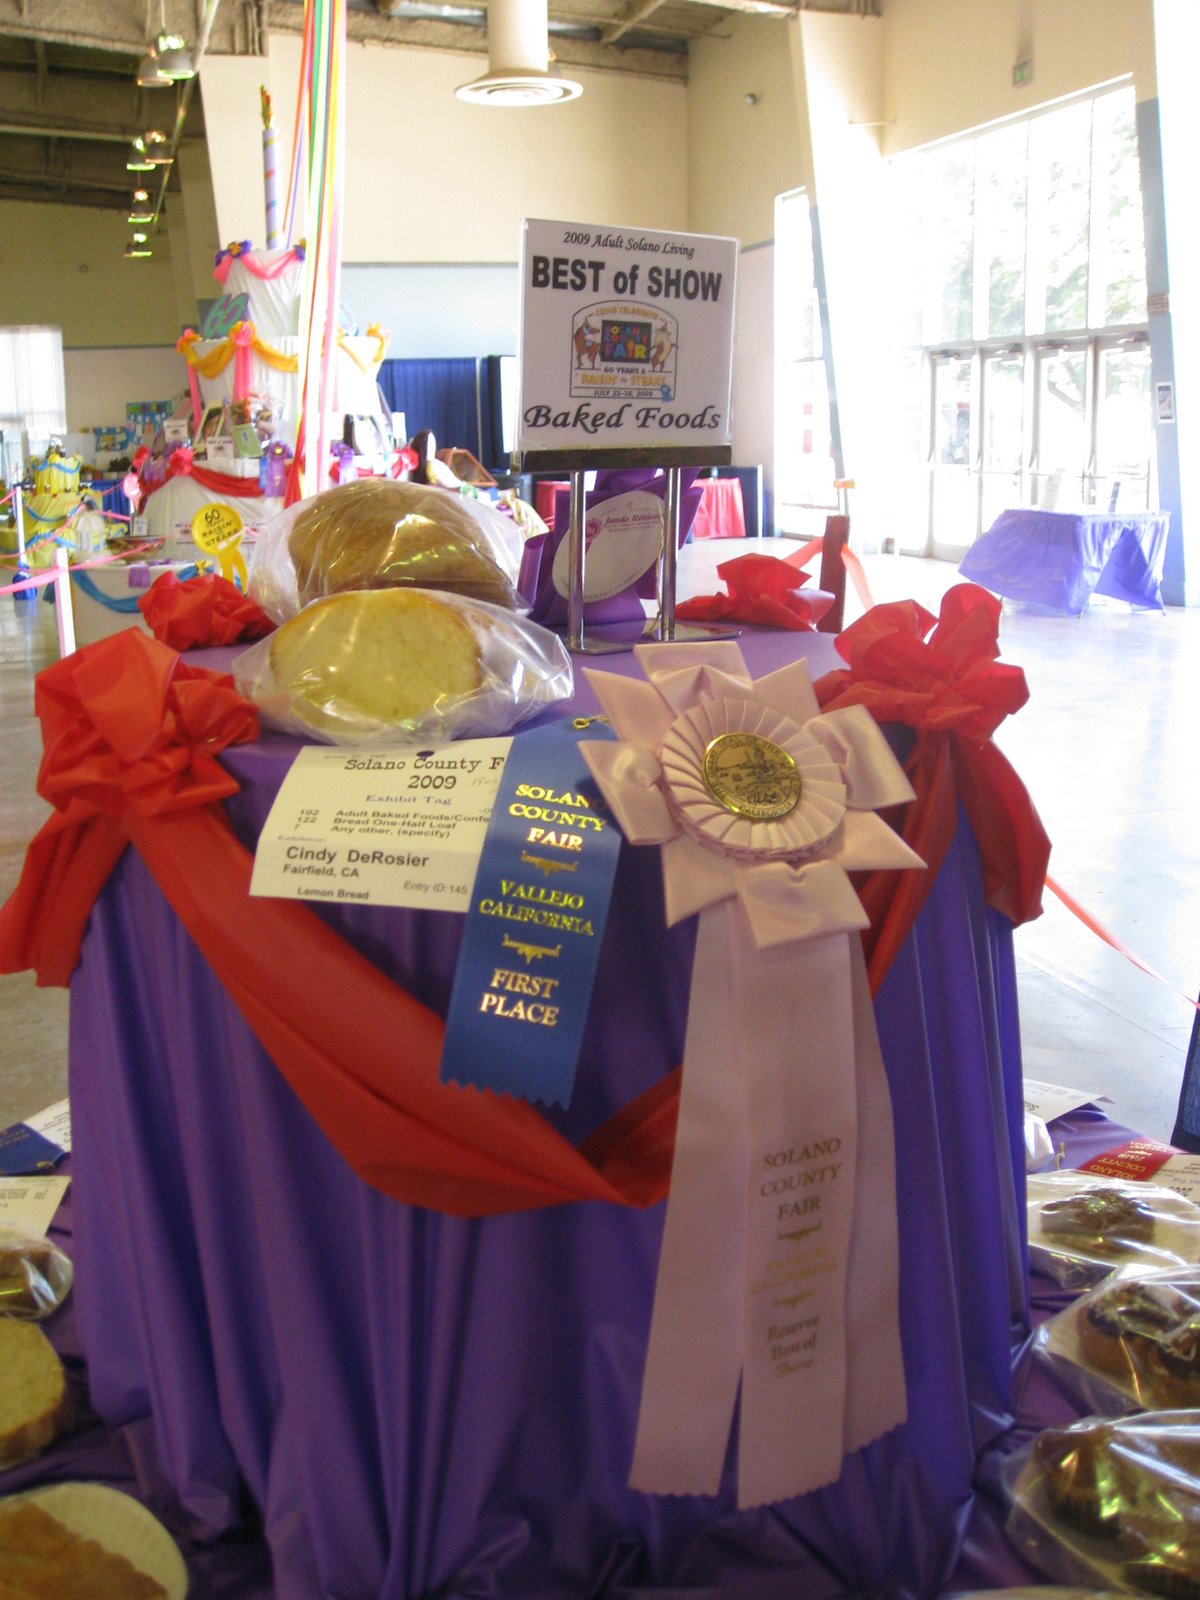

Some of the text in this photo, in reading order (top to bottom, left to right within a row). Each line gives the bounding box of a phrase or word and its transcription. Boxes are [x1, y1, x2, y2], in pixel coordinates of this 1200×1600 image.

[563, 231, 695, 260] 2009 Adult Solano Living
[531, 255, 722, 302] BEST of SHOW
[604, 341, 646, 360] FAIR
[523, 402, 721, 434] Baked Foods
[205, 509, 220, 523] 60
[343, 759, 406, 770] Solano
[413, 757, 482, 773] County
[408, 775, 457, 789] 2009
[333, 817, 369, 825] Bread
[429, 822, 457, 830] Loaf
[336, 810, 368, 818] Adult
[371, 811, 409, 820] Baked
[508, 803, 605, 832] COUNTY
[331, 825, 355, 834] Any
[397, 828, 450, 838] (specify)
[526, 827, 584, 851] FAIR
[286, 846, 430, 867] Cindy DeRosier
[283, 864, 360, 878] Fairfield, CA
[337, 889, 370, 900] Bread
[403, 880, 430, 893] Entry
[450, 884, 468, 894] 145
[501, 879, 584, 909] VALLEJO
[479, 898, 594, 936] CALIFORNIA
[490, 968, 559, 999] FIRST
[480, 992, 560, 1027] PLACE
[763, 1137, 842, 1171] SOLANO
[1097, 1157, 1146, 1172] COUNTY
[760, 1163, 843, 1197] COUNTY
[777, 1196, 821, 1220] FAIR
